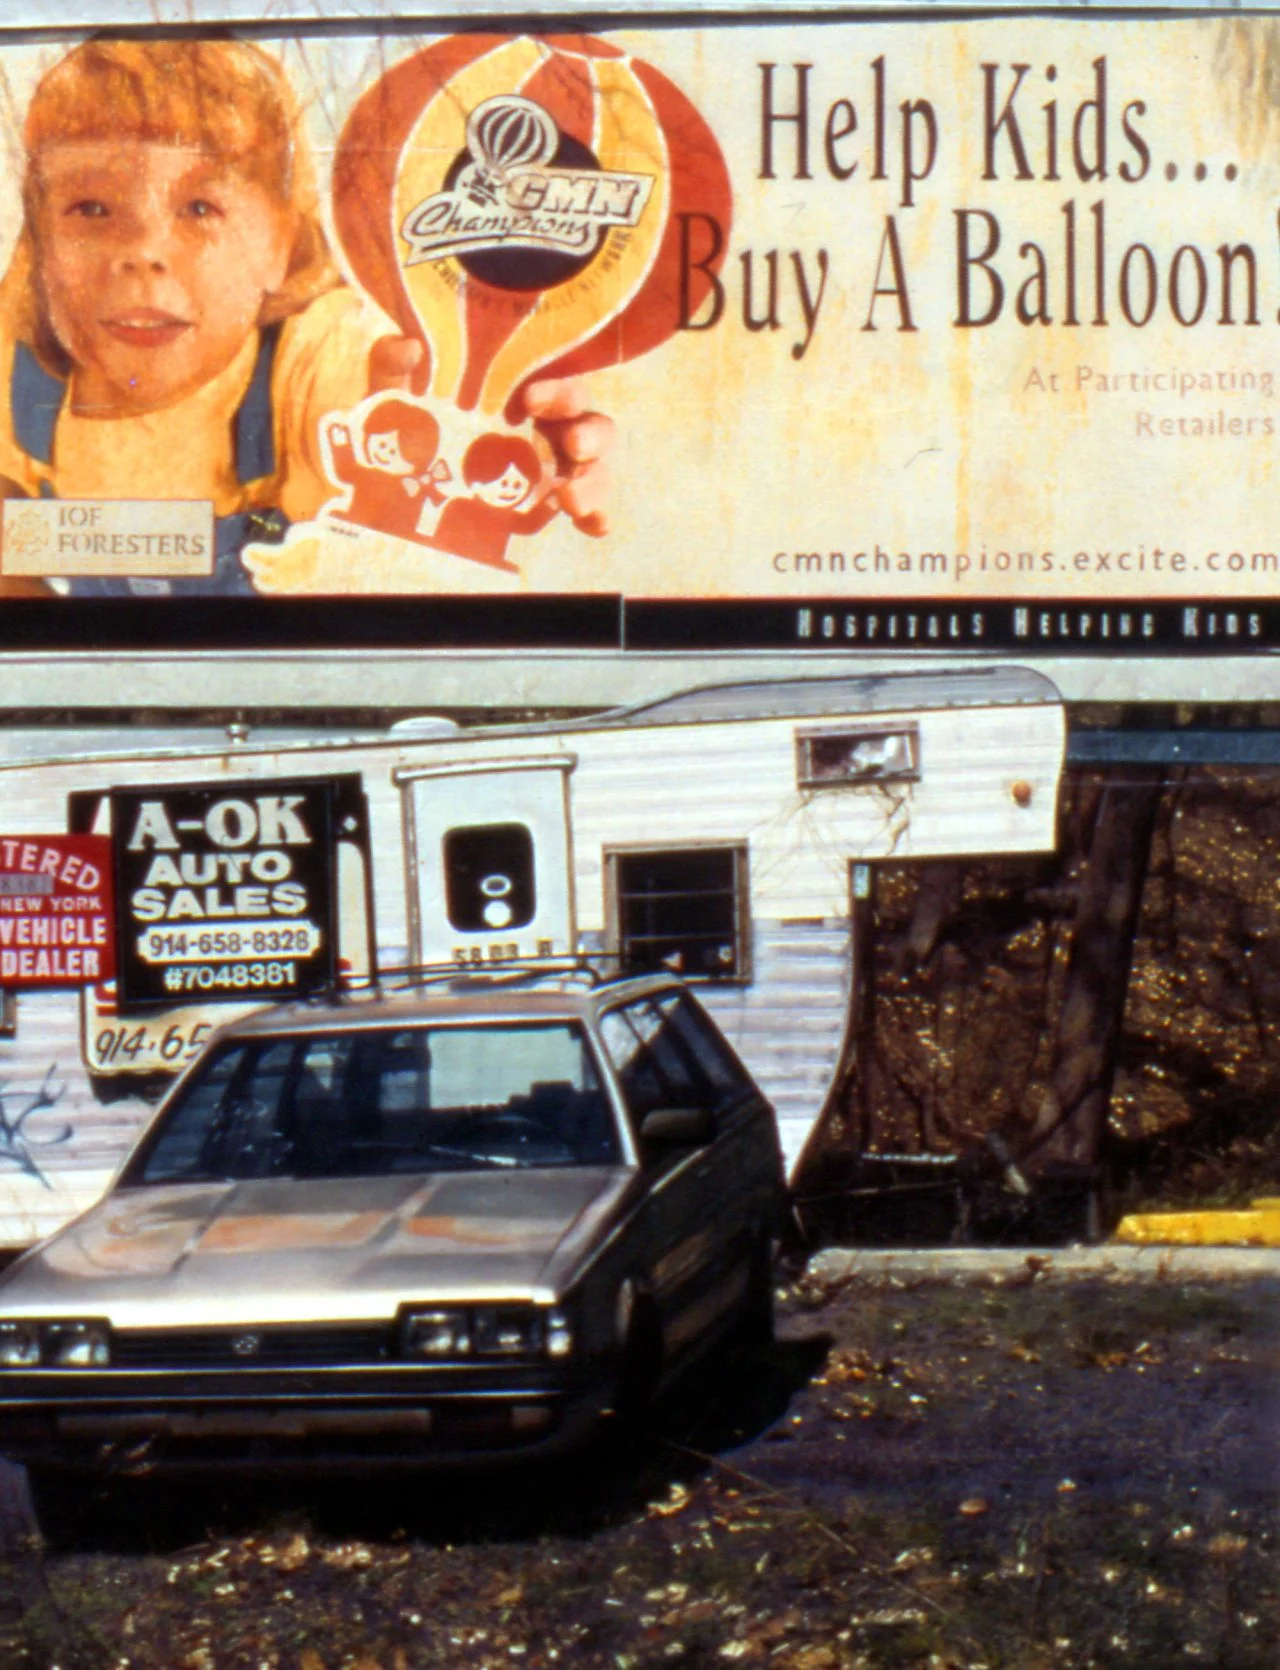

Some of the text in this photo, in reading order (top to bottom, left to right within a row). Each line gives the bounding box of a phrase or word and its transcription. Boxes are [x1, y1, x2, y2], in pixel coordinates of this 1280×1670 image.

[757, 55, 1238, 206] Help Kids...
[506, 173, 639, 217] CMN
[412, 201, 589, 242] Champions
[674, 212, 828, 360] Buy
[861, 215, 918, 331] A
[1023, 366, 1275, 399] At Participating
[1134, 409, 1276, 437] Retailers
[57, 506, 103, 527] IOF
[57, 533, 205, 557] FORESTERS
[772, 544, 1279, 581] cmnchampions.excite.com
[127, 796, 312, 850] A-OK
[144, 850, 292, 887] AUTO
[0, 897, 43, 912] NEW
[51, 896, 103, 911] YORK
[131, 882, 308, 921] SALES
[149, 928, 310, 958] 914-658-8328
[0, 949, 100, 978] DEALER
[163, 962, 297, 990] #7048381
